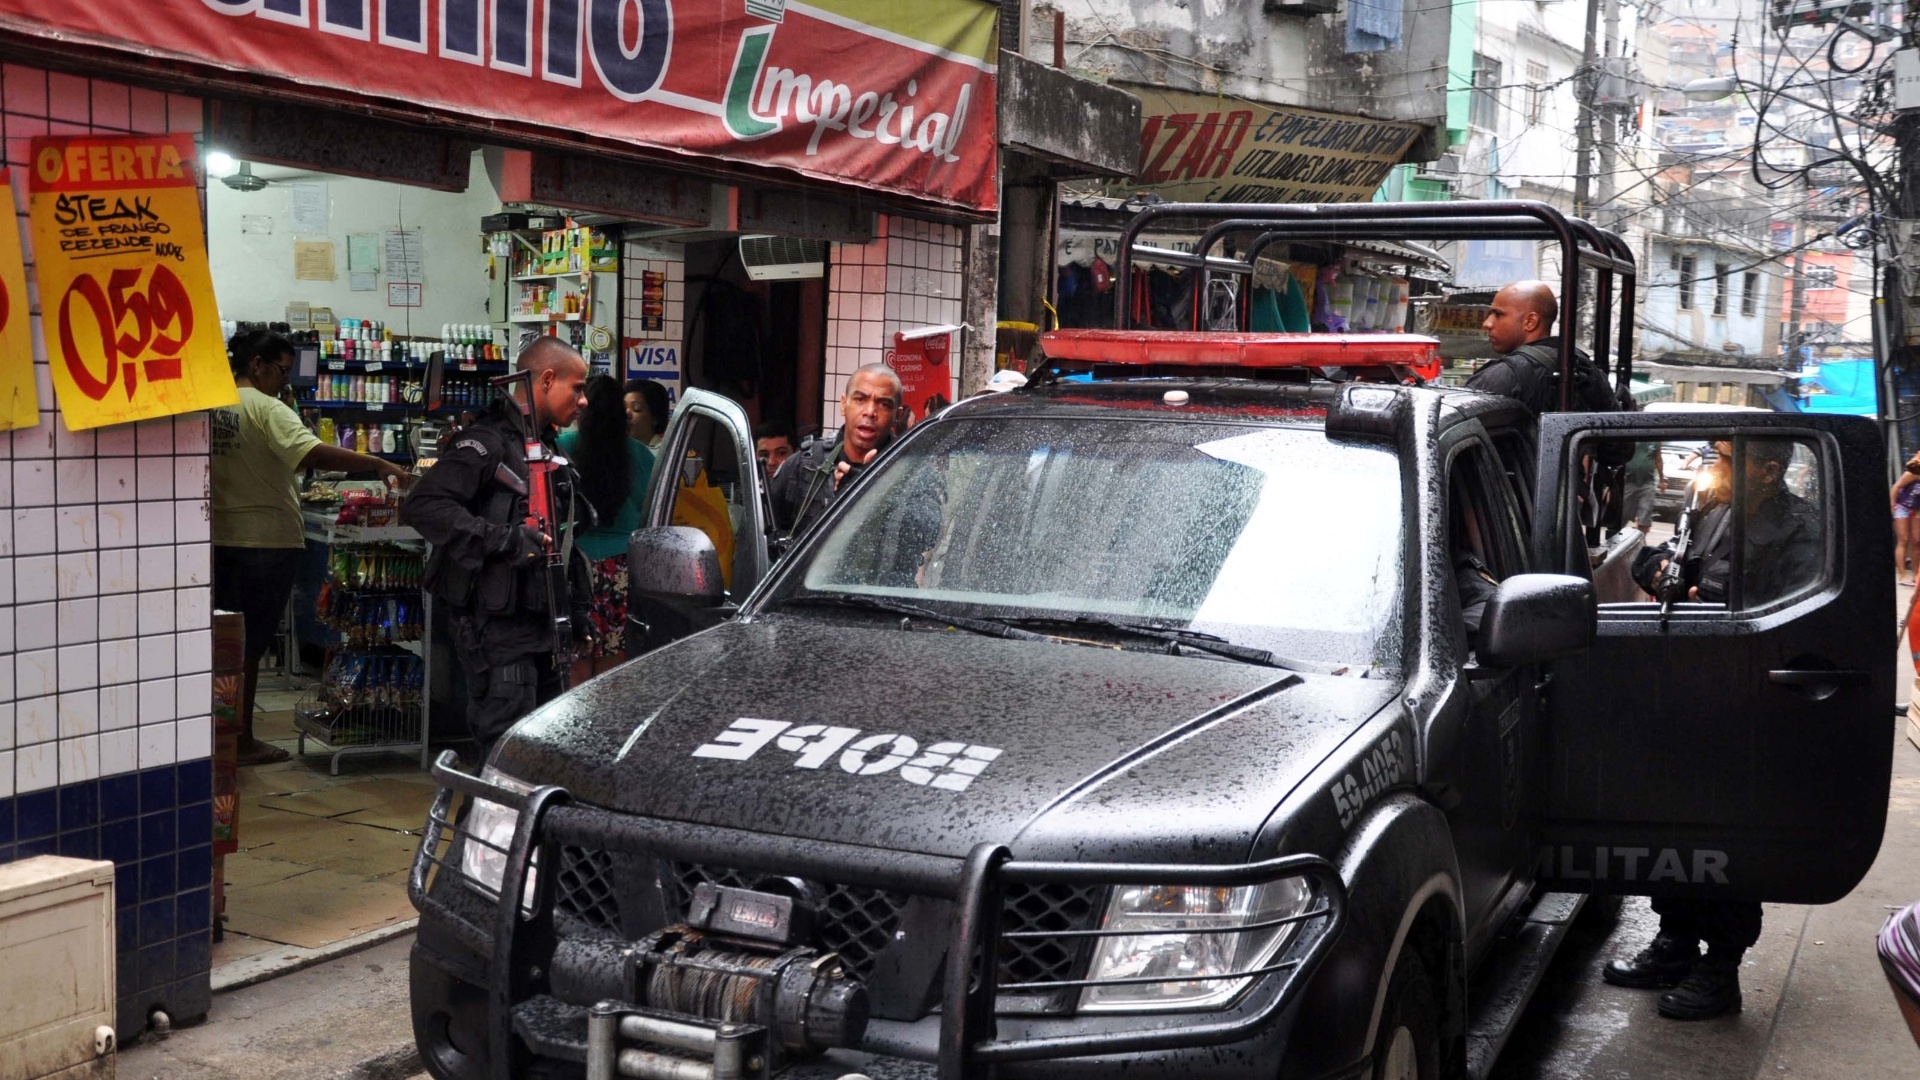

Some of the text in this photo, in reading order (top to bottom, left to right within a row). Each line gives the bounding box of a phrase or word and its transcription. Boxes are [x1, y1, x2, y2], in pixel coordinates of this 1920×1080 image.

[722, 23, 971, 163] Imperial
[1254, 112, 1282, 142] E
[37, 145, 185, 184] OFERTA
[1233, 149, 1321, 184] UTILIDADES
[54, 193, 159, 225] STEAK
[60, 222, 170, 238] DE FRANGO
[60, 236, 153, 252] REZENDE
[1065, 240, 1074, 255] E
[592, 353, 610, 361] VISA
[634, 347, 678, 366] VISA
[897, 354, 922, 362] ECONOMIA
[591, 367, 610, 375] VISA
[900, 364, 923, 372] CARINHO
[691, 717, 1004, 792] BOPE
[1540, 845, 1729, 884] ILITAR
